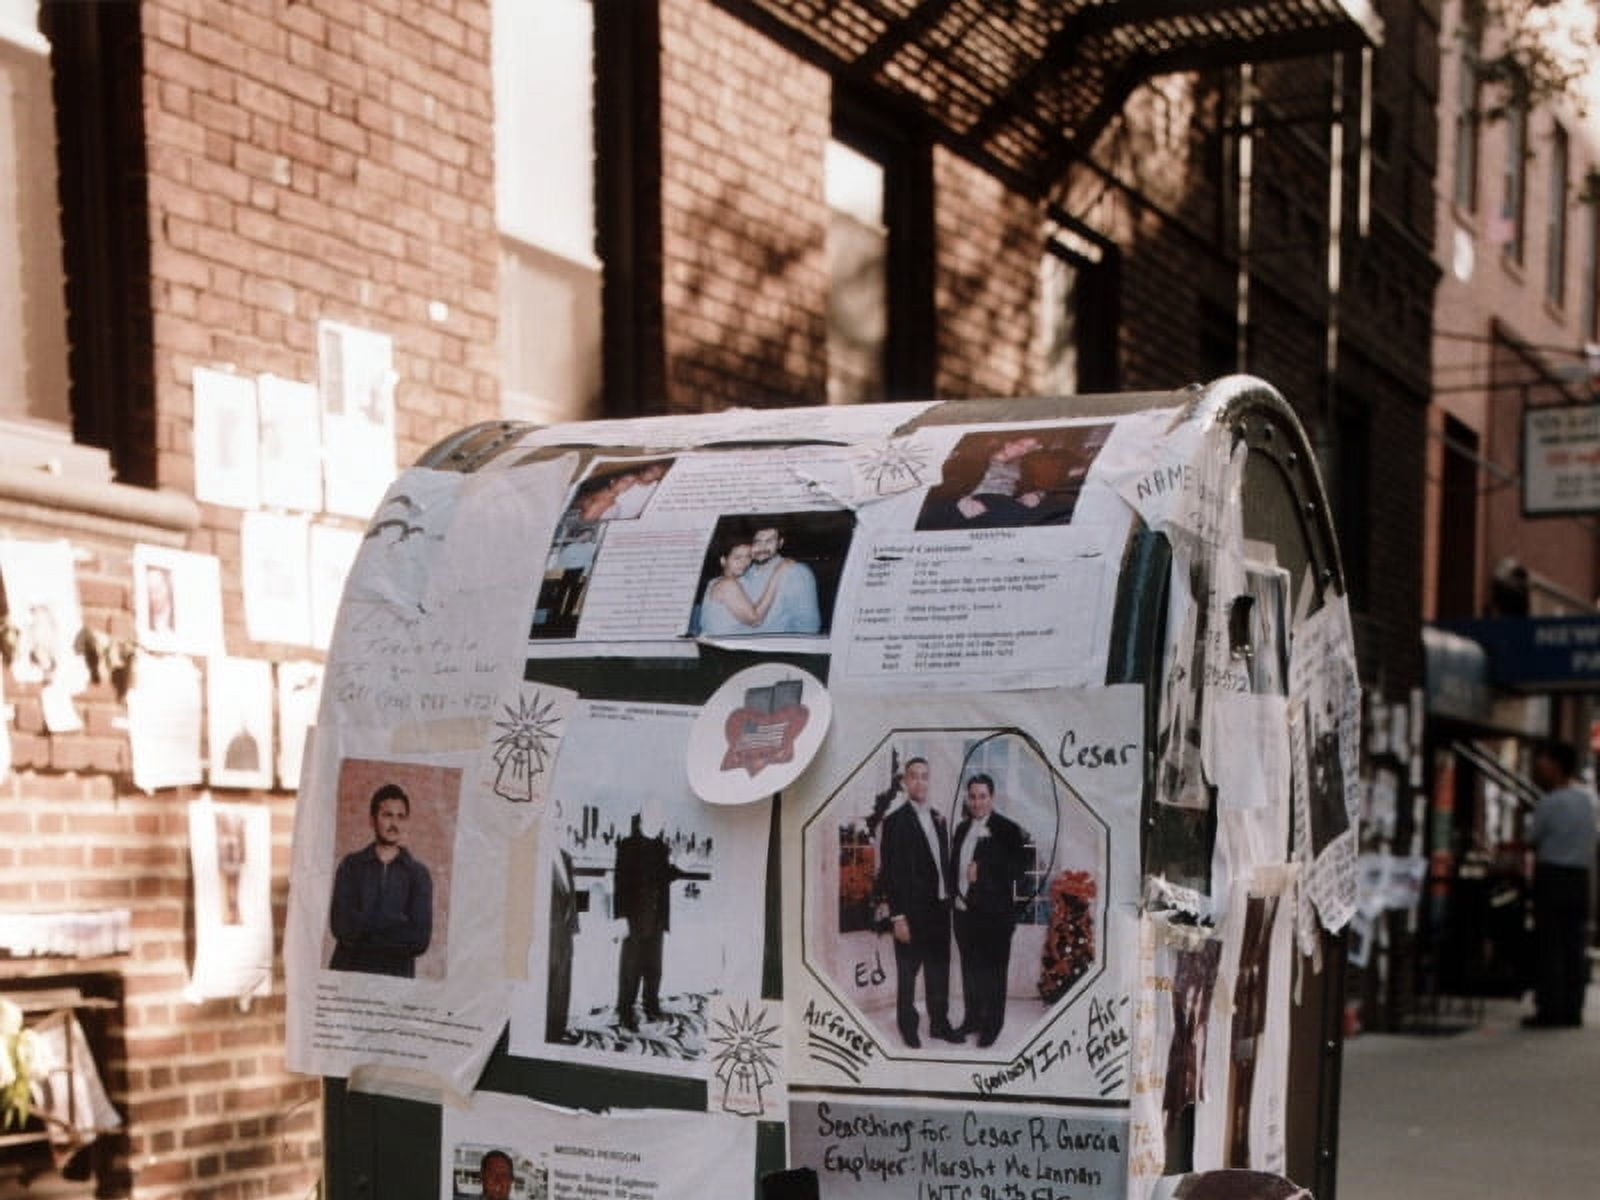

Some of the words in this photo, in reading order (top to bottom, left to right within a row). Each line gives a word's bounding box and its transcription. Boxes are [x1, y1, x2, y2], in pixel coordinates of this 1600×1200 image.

[1058, 730, 1137, 769] Cesar
[855, 947, 887, 988] Ed
[817, 1101, 914, 1153] Searching
[963, 1110, 1024, 1148] Cesar
[1056, 1118, 1121, 1153] Garcia
[823, 1144, 916, 1182] Employer:
[922, 1150, 985, 1179] Marsh
